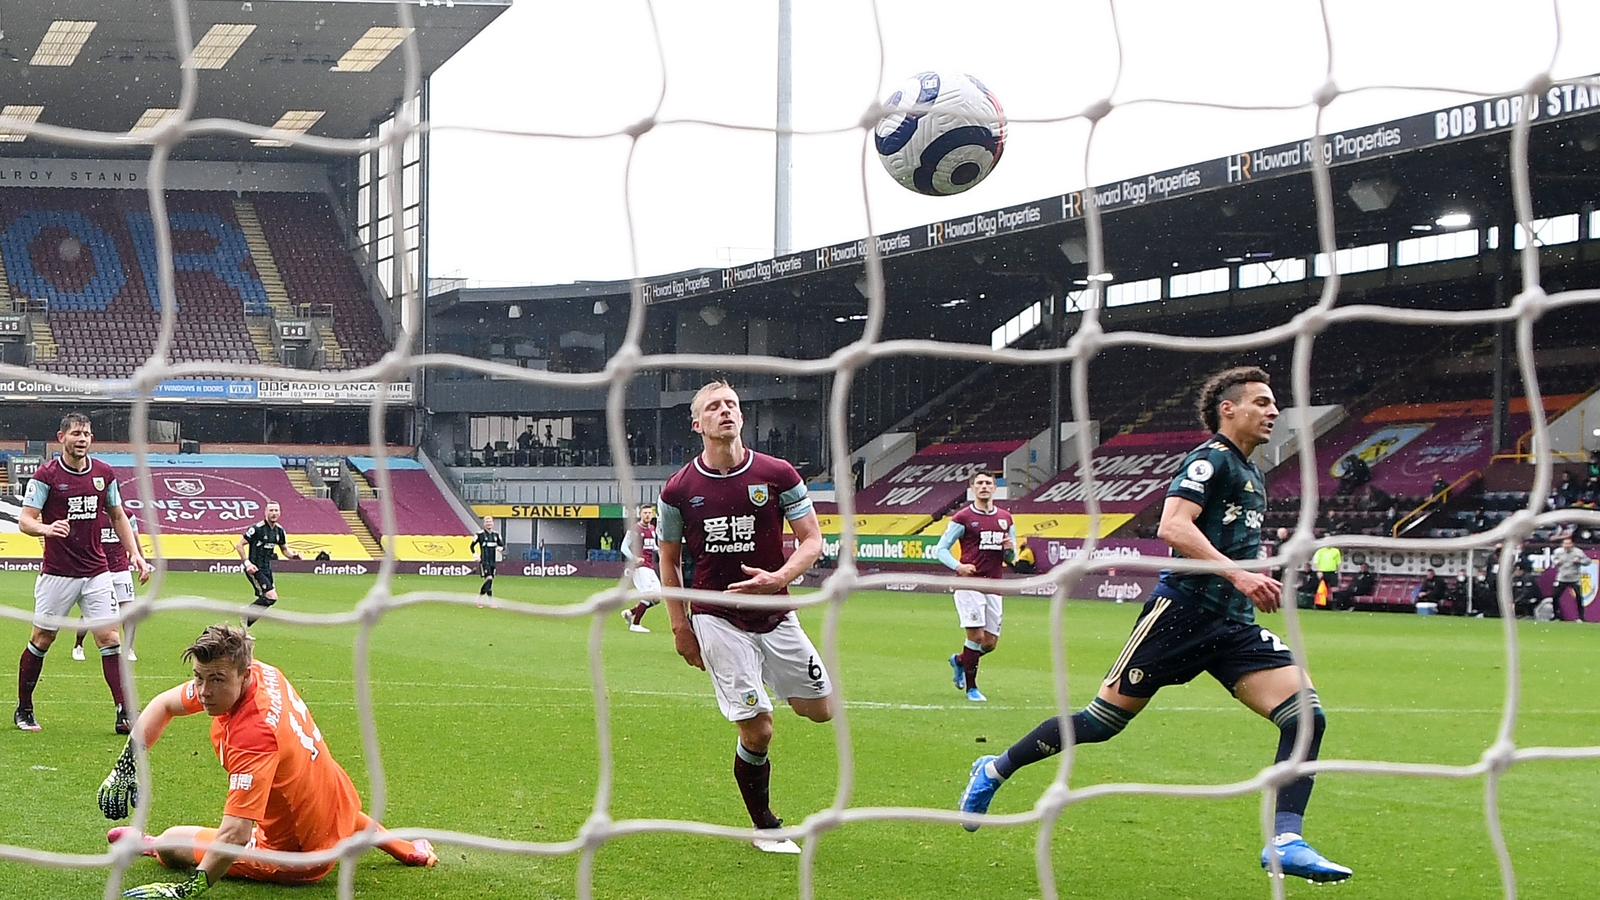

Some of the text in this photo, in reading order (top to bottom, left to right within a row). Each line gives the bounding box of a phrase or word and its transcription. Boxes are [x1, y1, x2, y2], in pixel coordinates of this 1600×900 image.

[1434, 106, 1477, 140] BOB
[1483, 93, 1540, 130] LORD
[1227, 126, 1401, 183] HR Howard Rg Properties
[0, 171, 138, 182] LROY STAND
[1062, 168, 1201, 219] HR Howard Rigg Properties
[927, 206, 1041, 246] HR Howard Rigg Properties
[830, 242, 857, 262] Howard
[857, 241, 869, 261] Rig
[876, 234, 911, 255] Properties
[734, 266, 757, 282] Howard
[757, 262, 771, 280] Rigg
[771, 256, 802, 276] Properties
[653, 281, 672, 298] Howard
[672, 280, 684, 297] Rigg
[684, 276, 710, 293] Properties
[18, 381, 52, 392] Colne
[164, 384, 195, 392] WINDOWS
[259, 382, 411, 391] BBC RADIO LANCASIRE
[329, 467, 339, 477] 12
[887, 464, 934, 483] WE
[1074, 454, 1162, 477] COME
[875, 486, 933, 506] YOU
[1033, 478, 1173, 503] BURNLEY
[125, 499, 260, 512] ONE CLUB
[164, 507, 257, 523] for all
[511, 504, 582, 518] STANLEY
[703, 515, 756, 543] 爱博
[704, 540, 756, 554] LoveBet
[884, 539, 939, 560] bet365.co
[1121, 547, 1141, 561] Club
[209, 561, 245, 573] claret
[314, 563, 358, 575] clarets
[419, 563, 463, 576] clarets
[523, 564, 568, 577] clarets
[1097, 580, 1134, 599] clarets
[808, 655, 823, 681] 6
